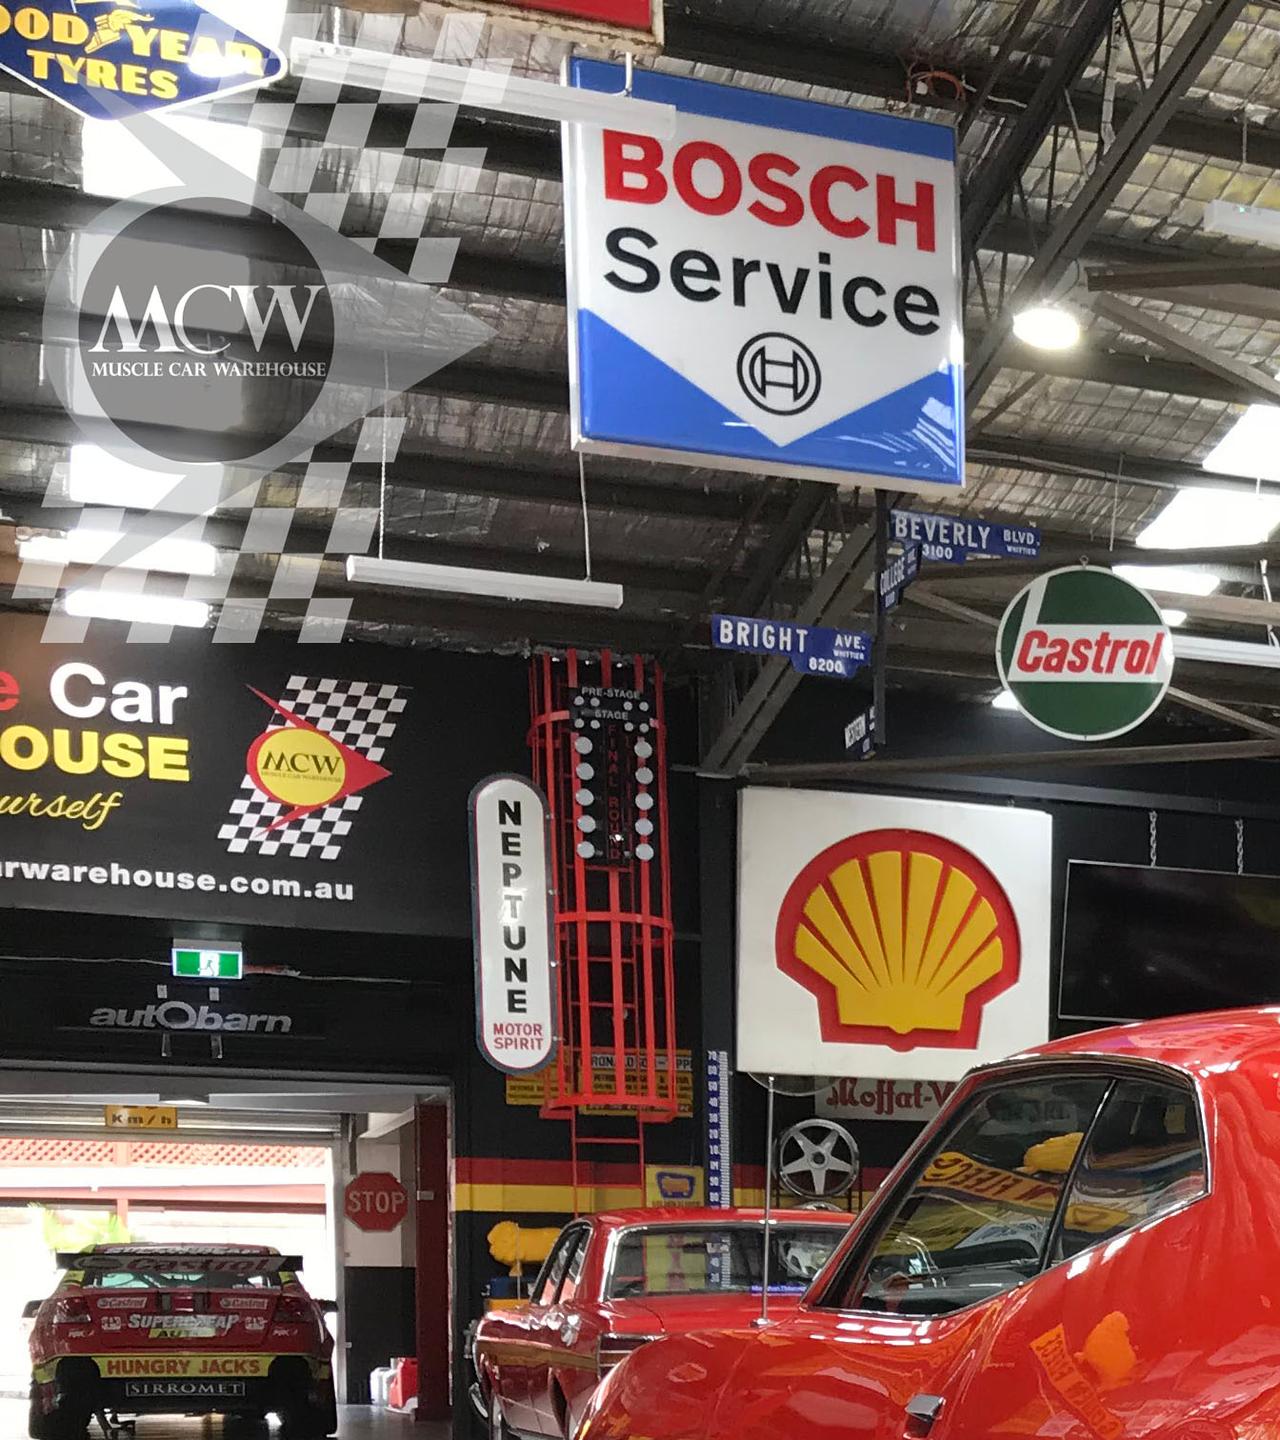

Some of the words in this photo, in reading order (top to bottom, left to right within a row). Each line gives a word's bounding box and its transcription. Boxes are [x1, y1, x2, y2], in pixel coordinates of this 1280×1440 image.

[26, 49, 179, 100] TYRES
[602, 130, 936, 253] BOSCH
[604, 227, 940, 335] Service
[895, 516, 991, 549] BEVERLY
[922, 544, 953, 560] 3100
[719, 619, 808, 653] BRIGHT
[1017, 630, 1165, 675] Castrol
[808, 657, 843, 673] 8200
[50, 662, 188, 725] Car
[581, 686, 640, 700] PRE-STAGE
[594, 710, 629, 721] STAGE
[262, 752, 343, 775] MCW
[0, 859, 354, 901] rwarehouse.com.au
[498, 800, 528, 1014] NEPTUNE
[493, 1023, 543, 1037] MOTOR
[493, 1037, 544, 1051] SPIRIT
[348, 1190, 404, 1213] STOP
[107, 1359, 191, 1375] HUNGRY
[130, 1382, 240, 1395] SIRROMET
